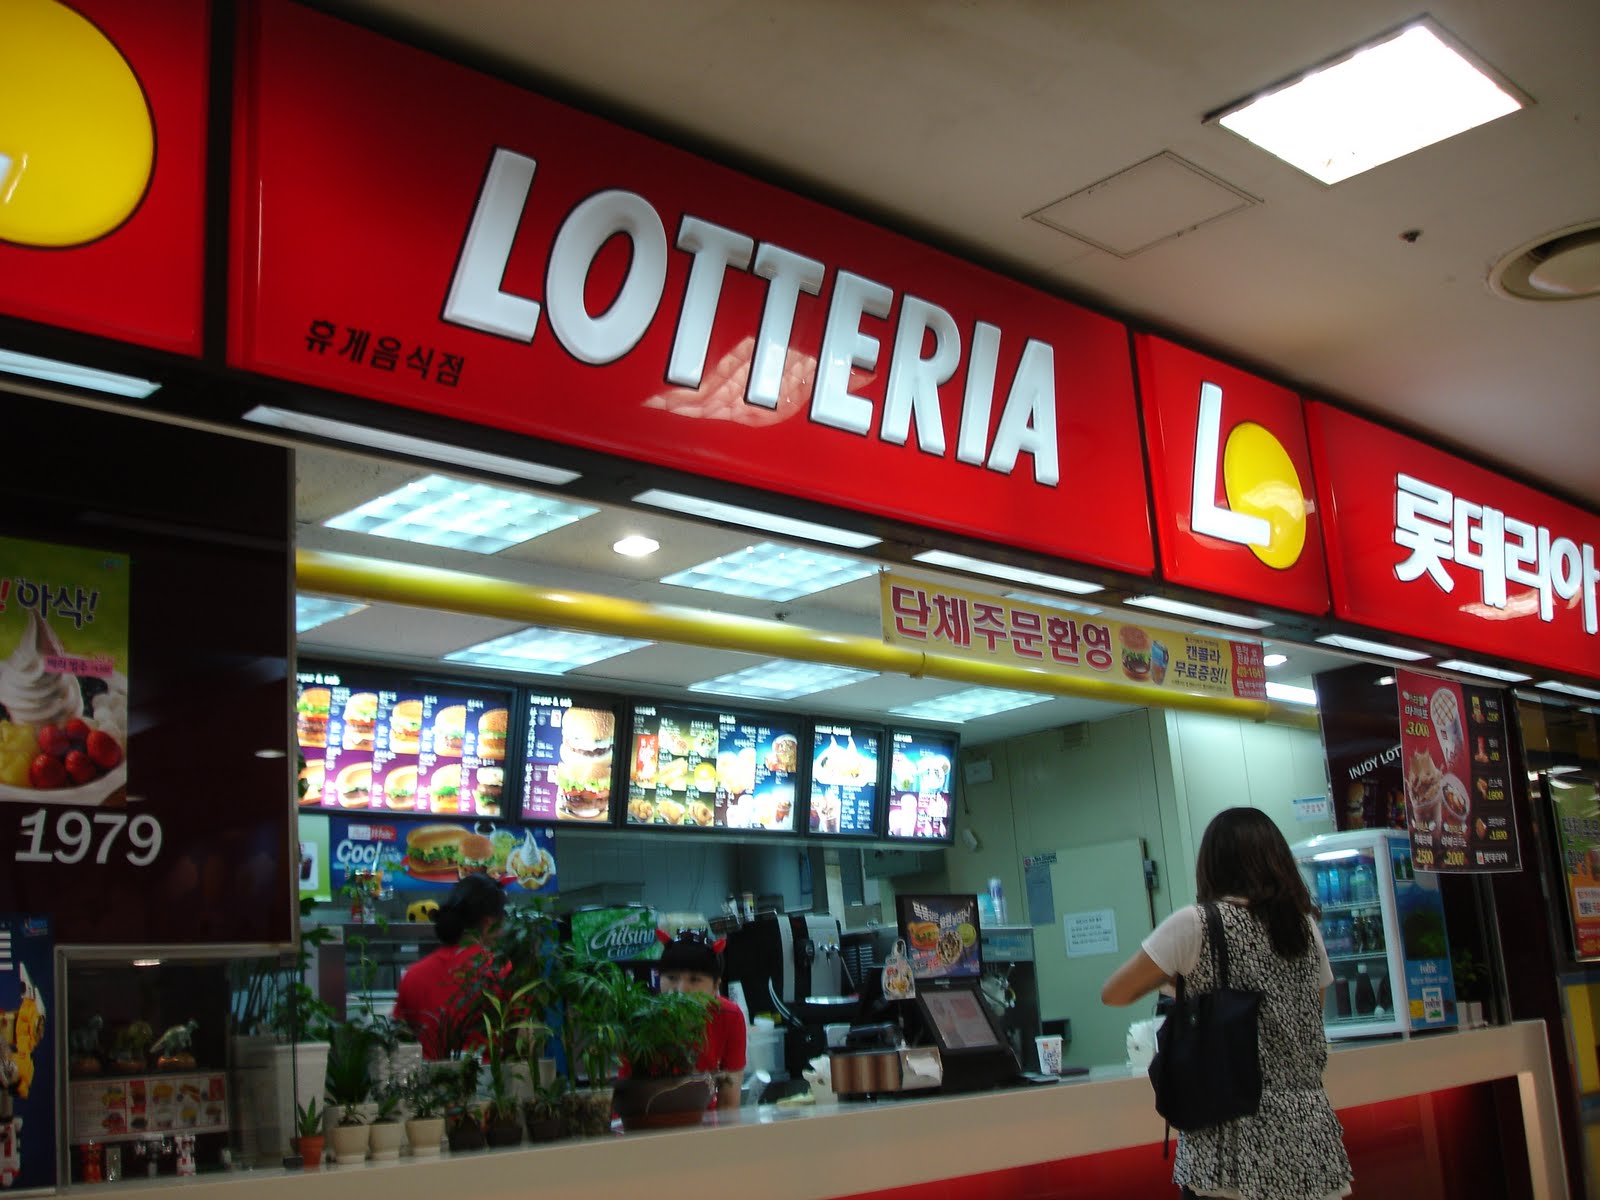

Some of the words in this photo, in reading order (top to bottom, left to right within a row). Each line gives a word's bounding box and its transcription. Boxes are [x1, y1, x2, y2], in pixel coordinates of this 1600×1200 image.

[303, 319, 465, 388] 휴게음식점
[442, 147, 1061, 487] LOTTERIA
[1394, 472, 1600, 637] 롯데리아
[890, 584, 1114, 672] 단체주문환영
[15, 808, 163, 866] 1979
